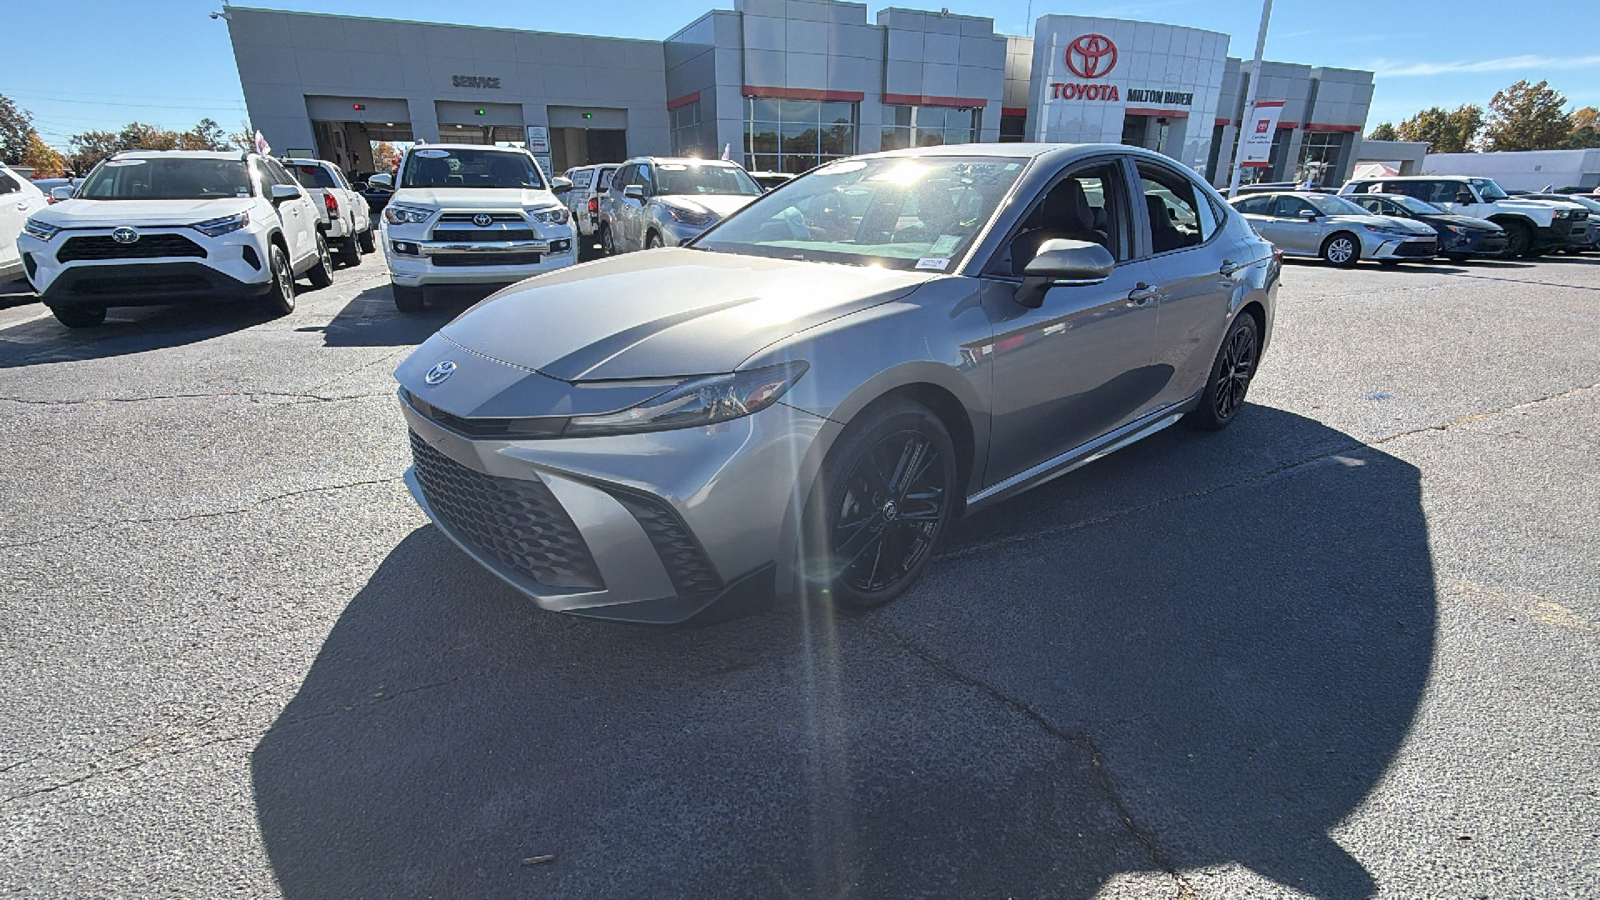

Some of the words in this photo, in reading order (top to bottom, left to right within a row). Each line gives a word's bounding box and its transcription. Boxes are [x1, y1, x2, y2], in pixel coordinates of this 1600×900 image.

[452, 75, 501, 89] SERVICE
[1050, 82, 1120, 101] TOYOTA
[1127, 88, 1164, 104] MILTON
[1163, 91, 1194, 106] RUBEN
